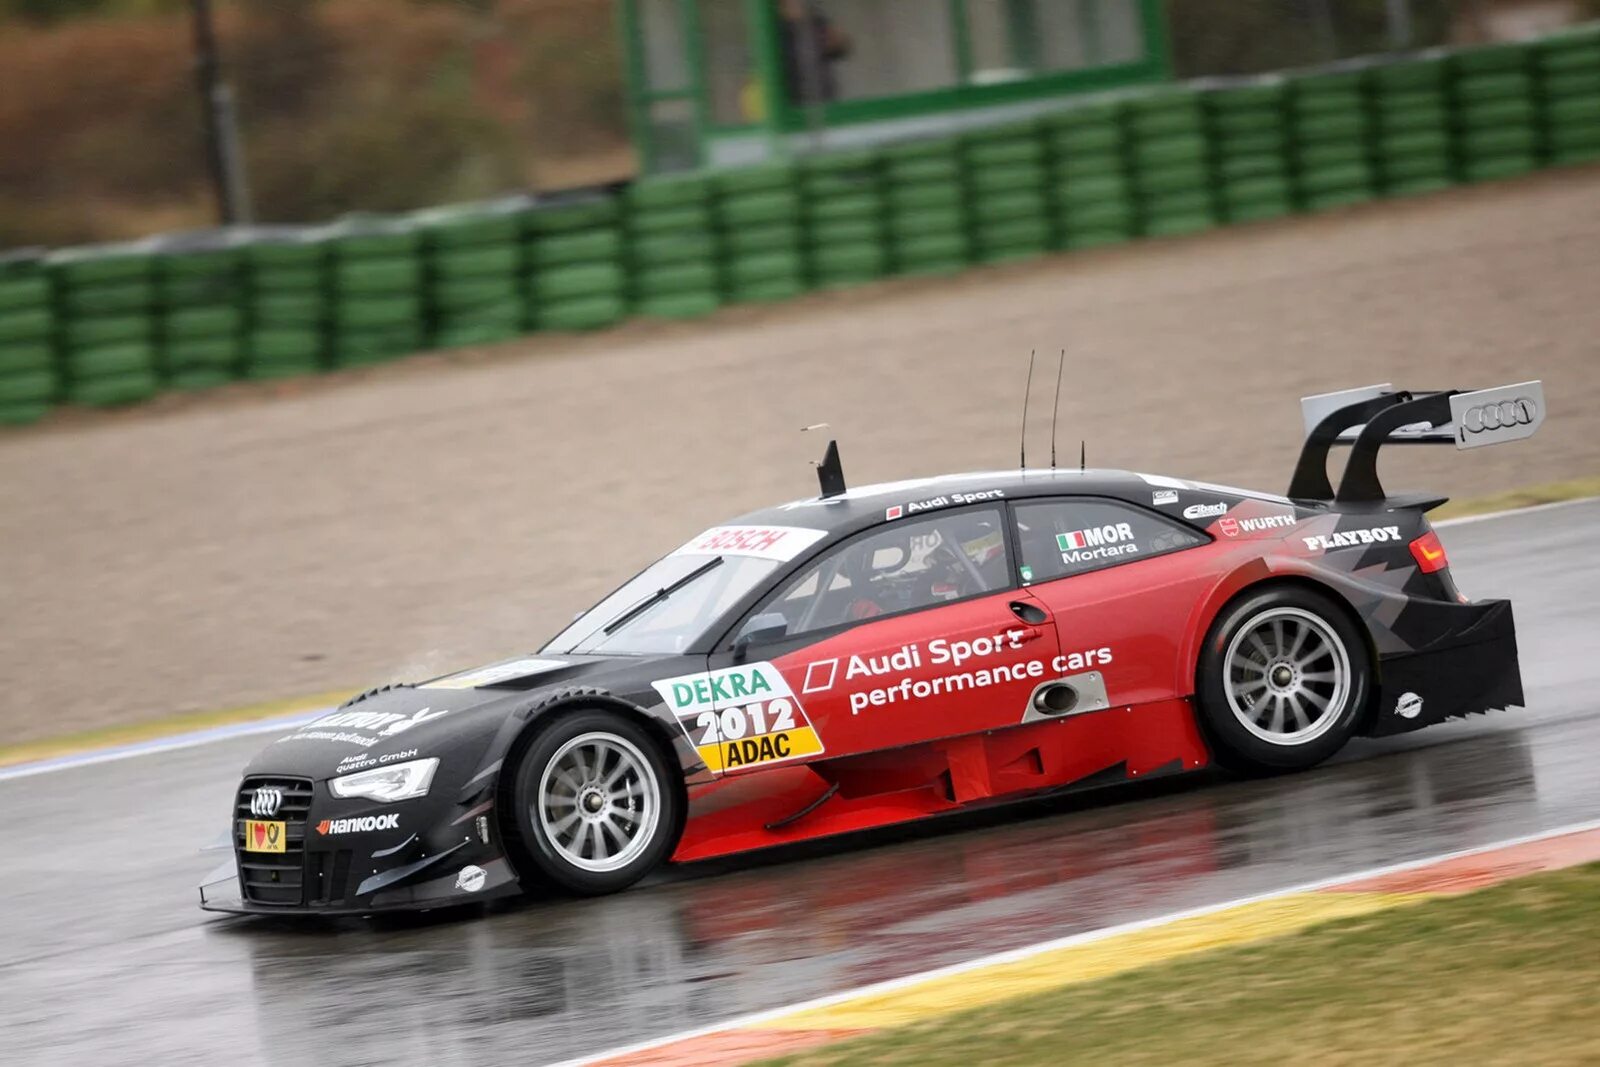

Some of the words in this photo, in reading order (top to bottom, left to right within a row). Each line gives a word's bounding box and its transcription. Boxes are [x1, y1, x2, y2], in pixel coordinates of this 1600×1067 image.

[908, 496, 949, 513] Audi
[951, 487, 1005, 506] Sport
[1183, 501, 1229, 520] Eibach
[698, 529, 788, 551] BOSCH
[1083, 522, 1135, 547] MOR
[1302, 526, 1402, 550] PLAYBOY
[1061, 542, 1139, 565] Mortara
[845, 645, 922, 680] Audi
[927, 629, 1025, 667] Sport
[672, 669, 772, 708] DEKRA
[849, 659, 1044, 715] performance
[1051, 646, 1114, 674] cars
[697, 698, 796, 745] 2012
[336, 759, 377, 774] quattro
[379, 748, 418, 763] GmbH
[340, 753, 369, 764] Audi
[727, 733, 791, 767] ADAC
